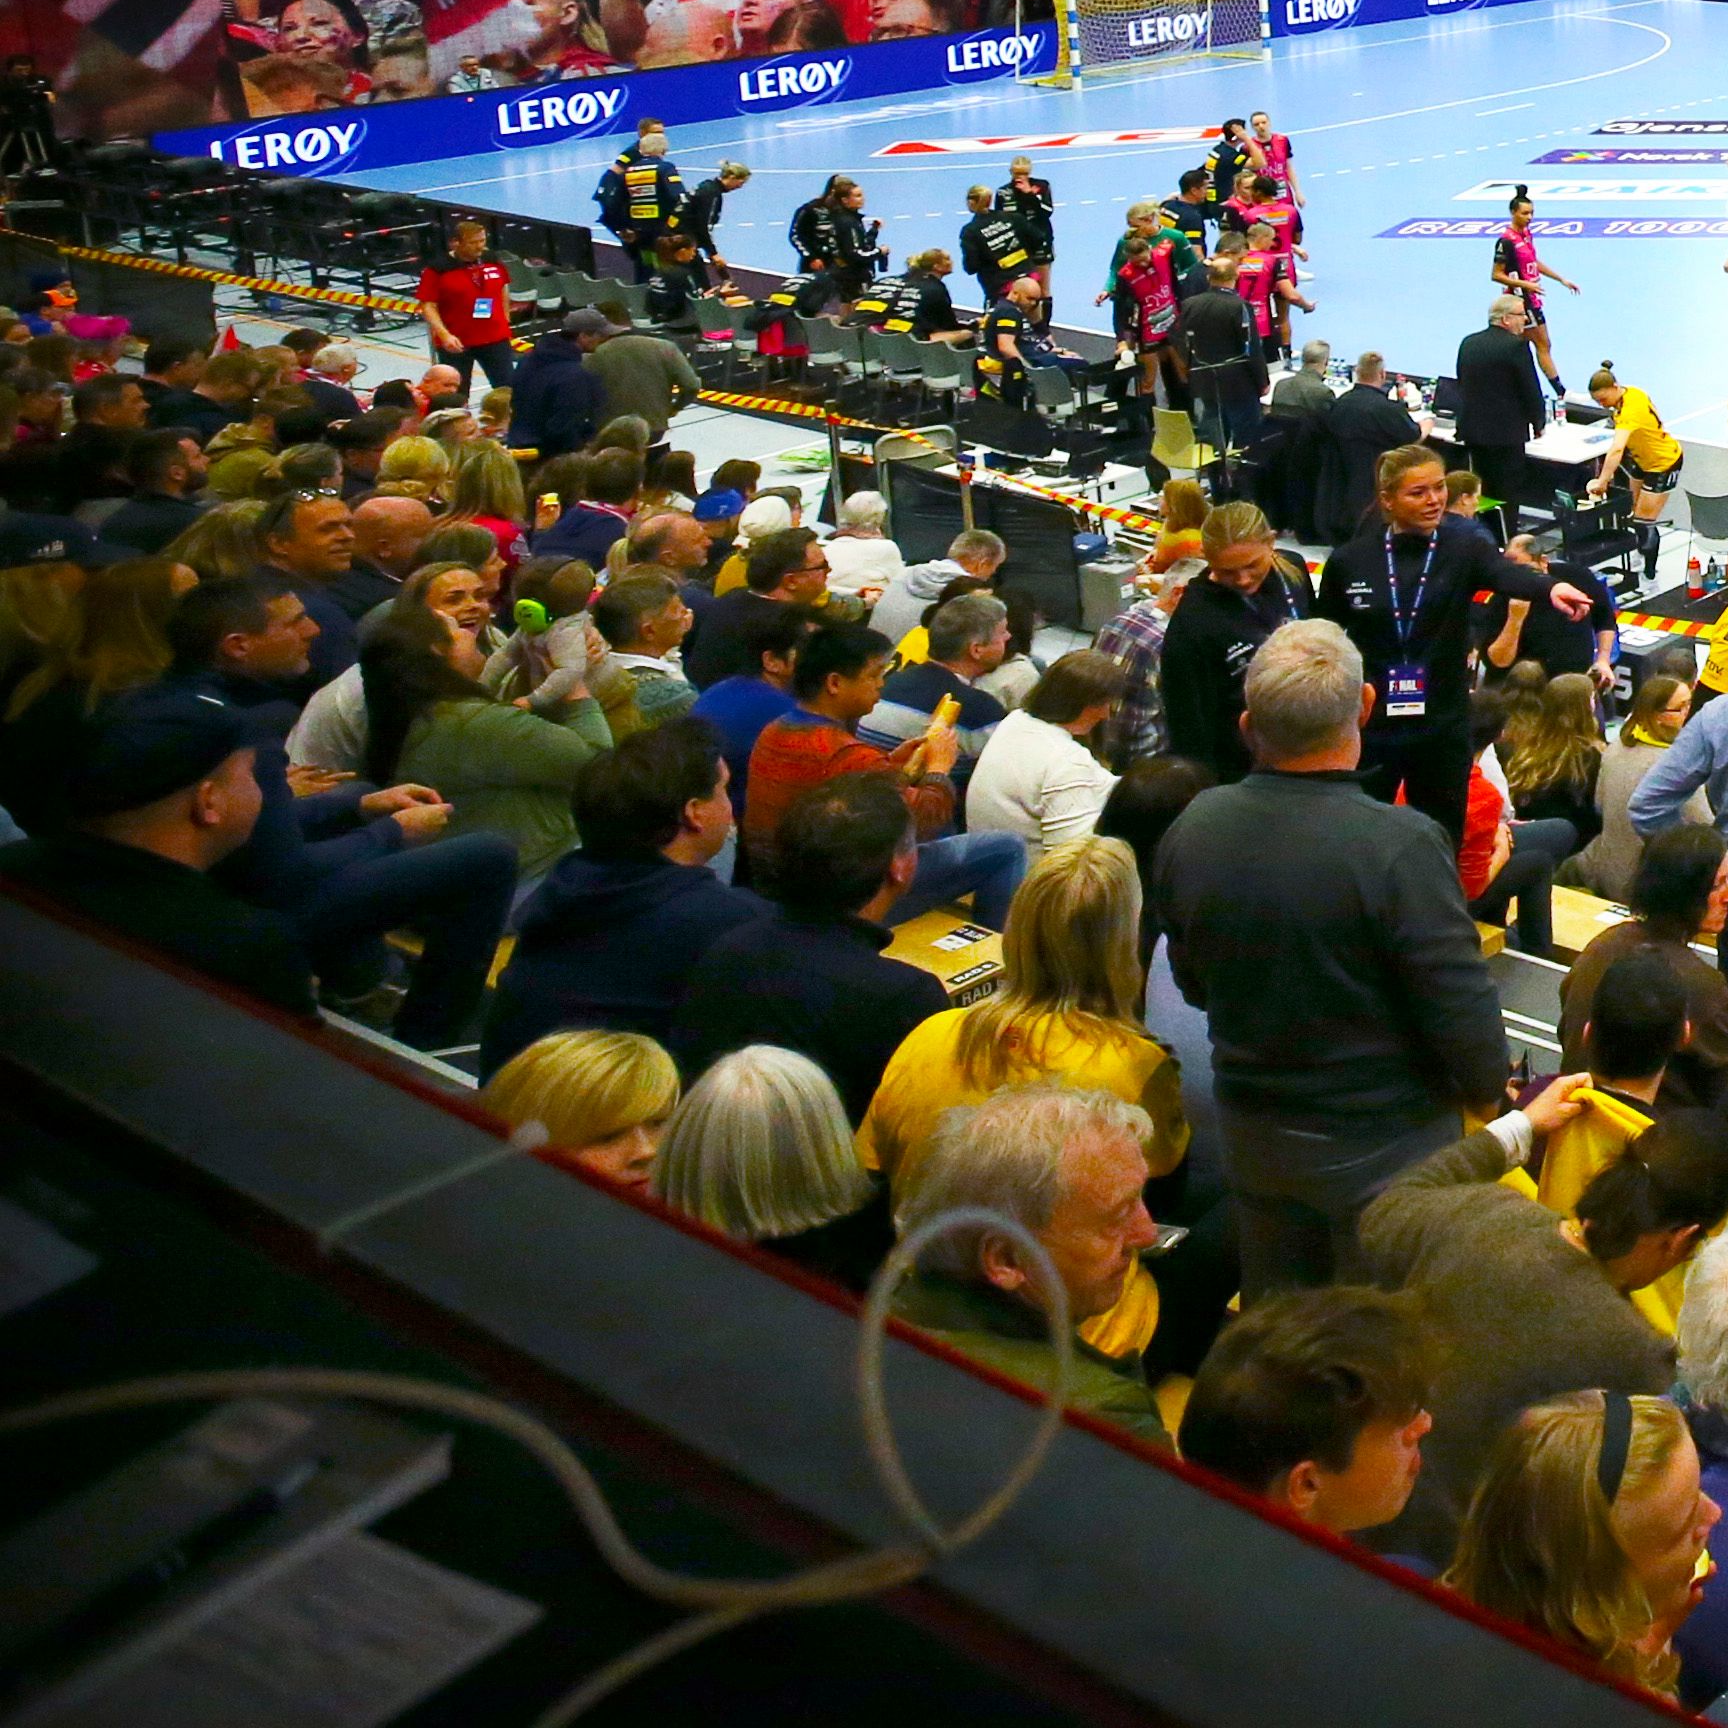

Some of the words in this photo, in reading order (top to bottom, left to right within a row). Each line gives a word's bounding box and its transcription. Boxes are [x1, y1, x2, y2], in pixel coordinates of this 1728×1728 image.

[1128, 12, 1208, 47] LERØY
[948, 33, 1039, 72] LERØY
[738, 58, 846, 102] LERØY
[498, 89, 621, 136] LERØY
